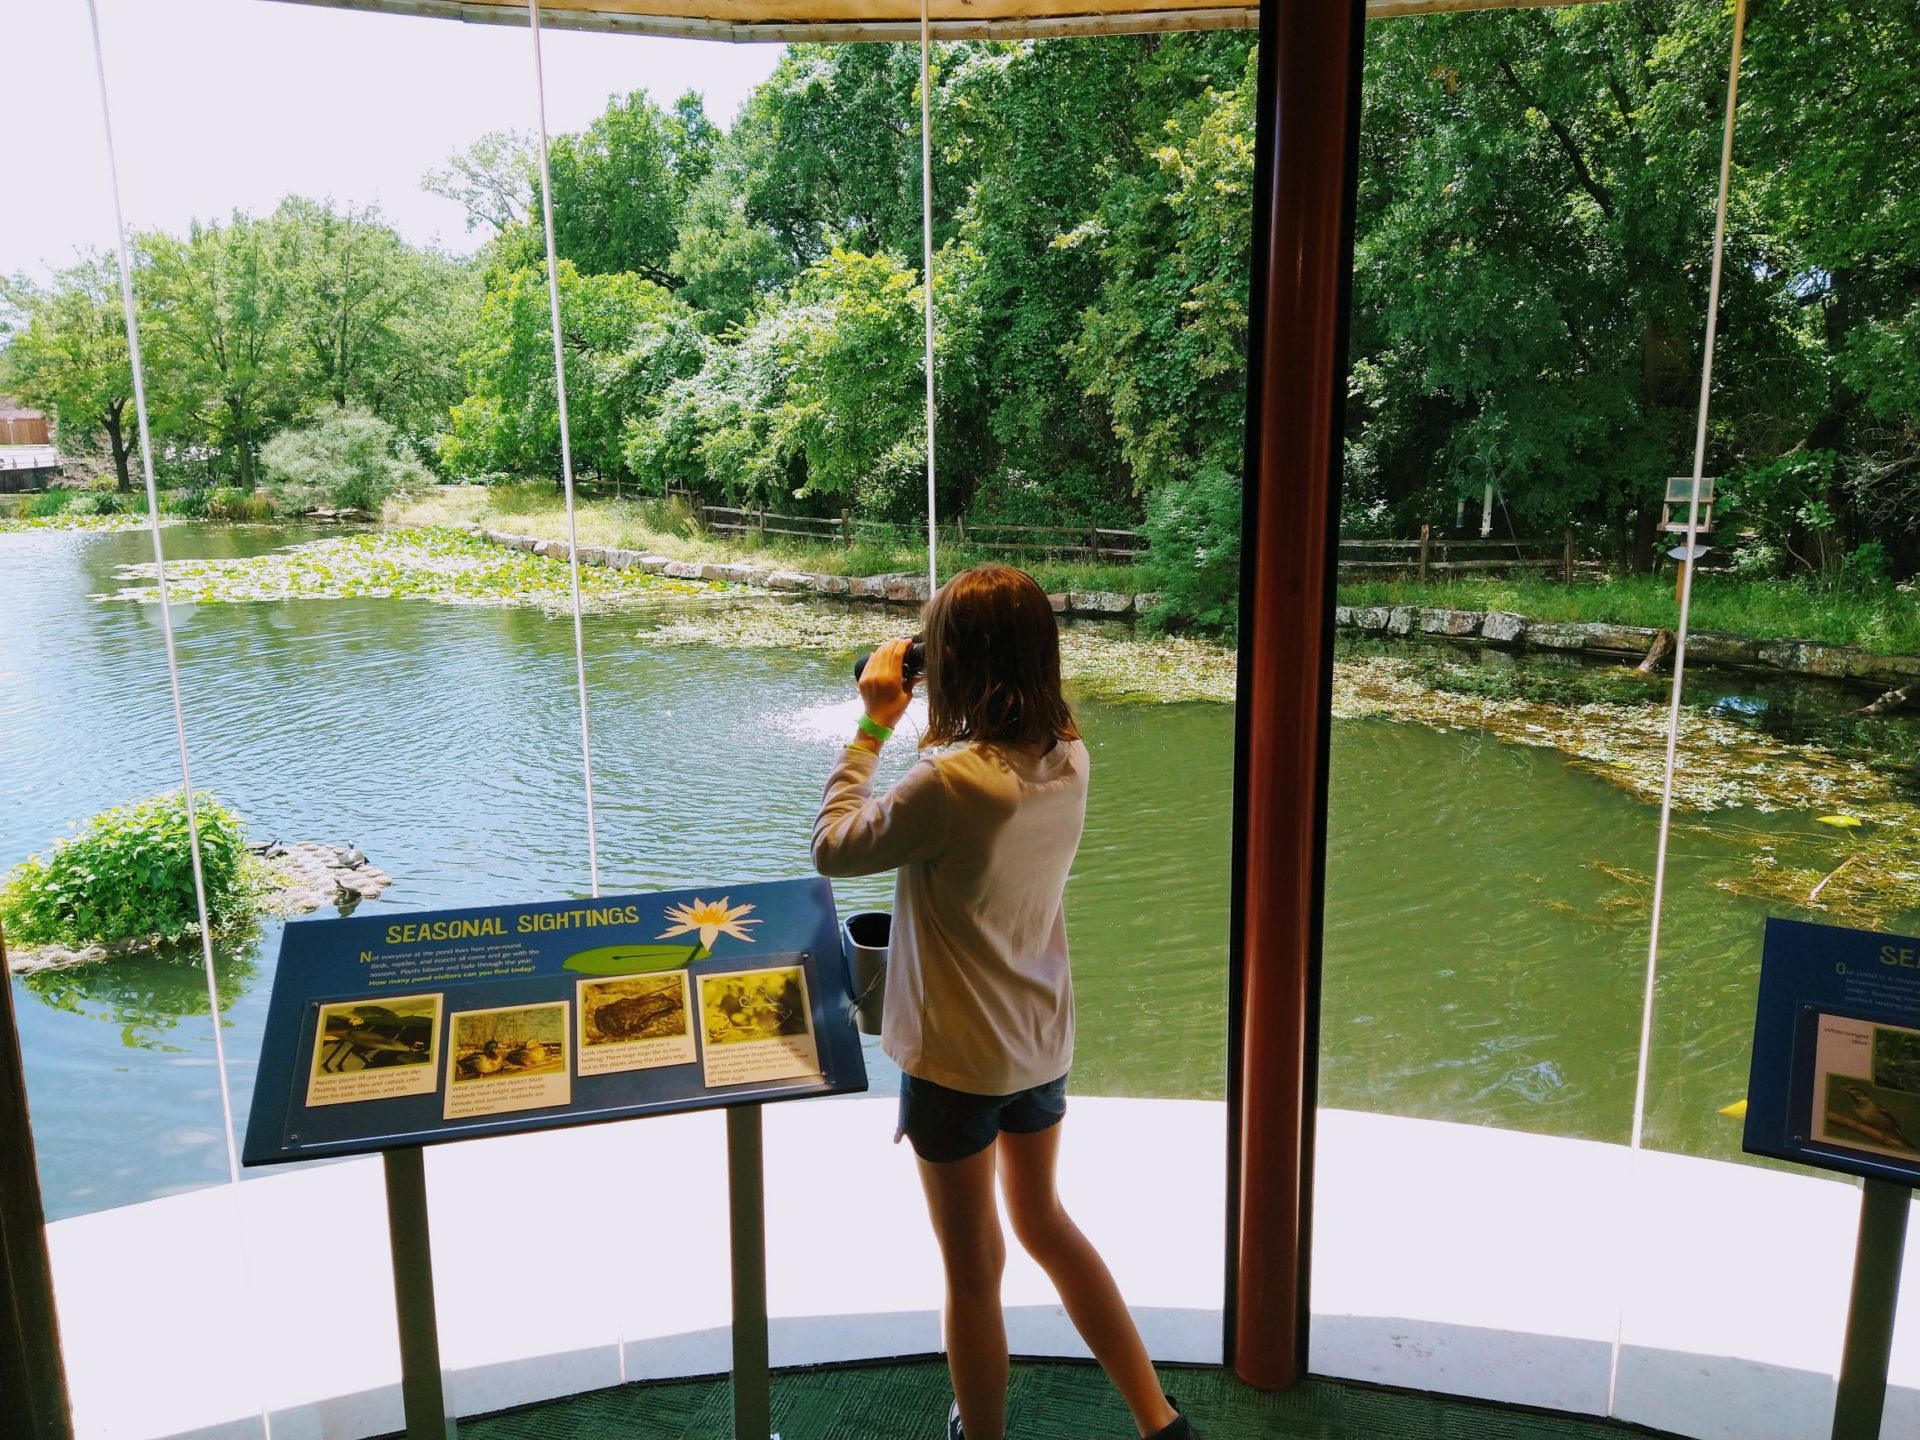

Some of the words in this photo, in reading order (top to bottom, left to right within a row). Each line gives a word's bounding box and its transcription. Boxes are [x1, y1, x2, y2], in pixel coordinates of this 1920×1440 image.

[385, 915, 508, 944] SEASONAL
[517, 905, 640, 933] SIGHTINGS
[435, 949, 453, 957] pond
[1879, 944, 1920, 969] SE
[412, 975, 432, 983] pond
